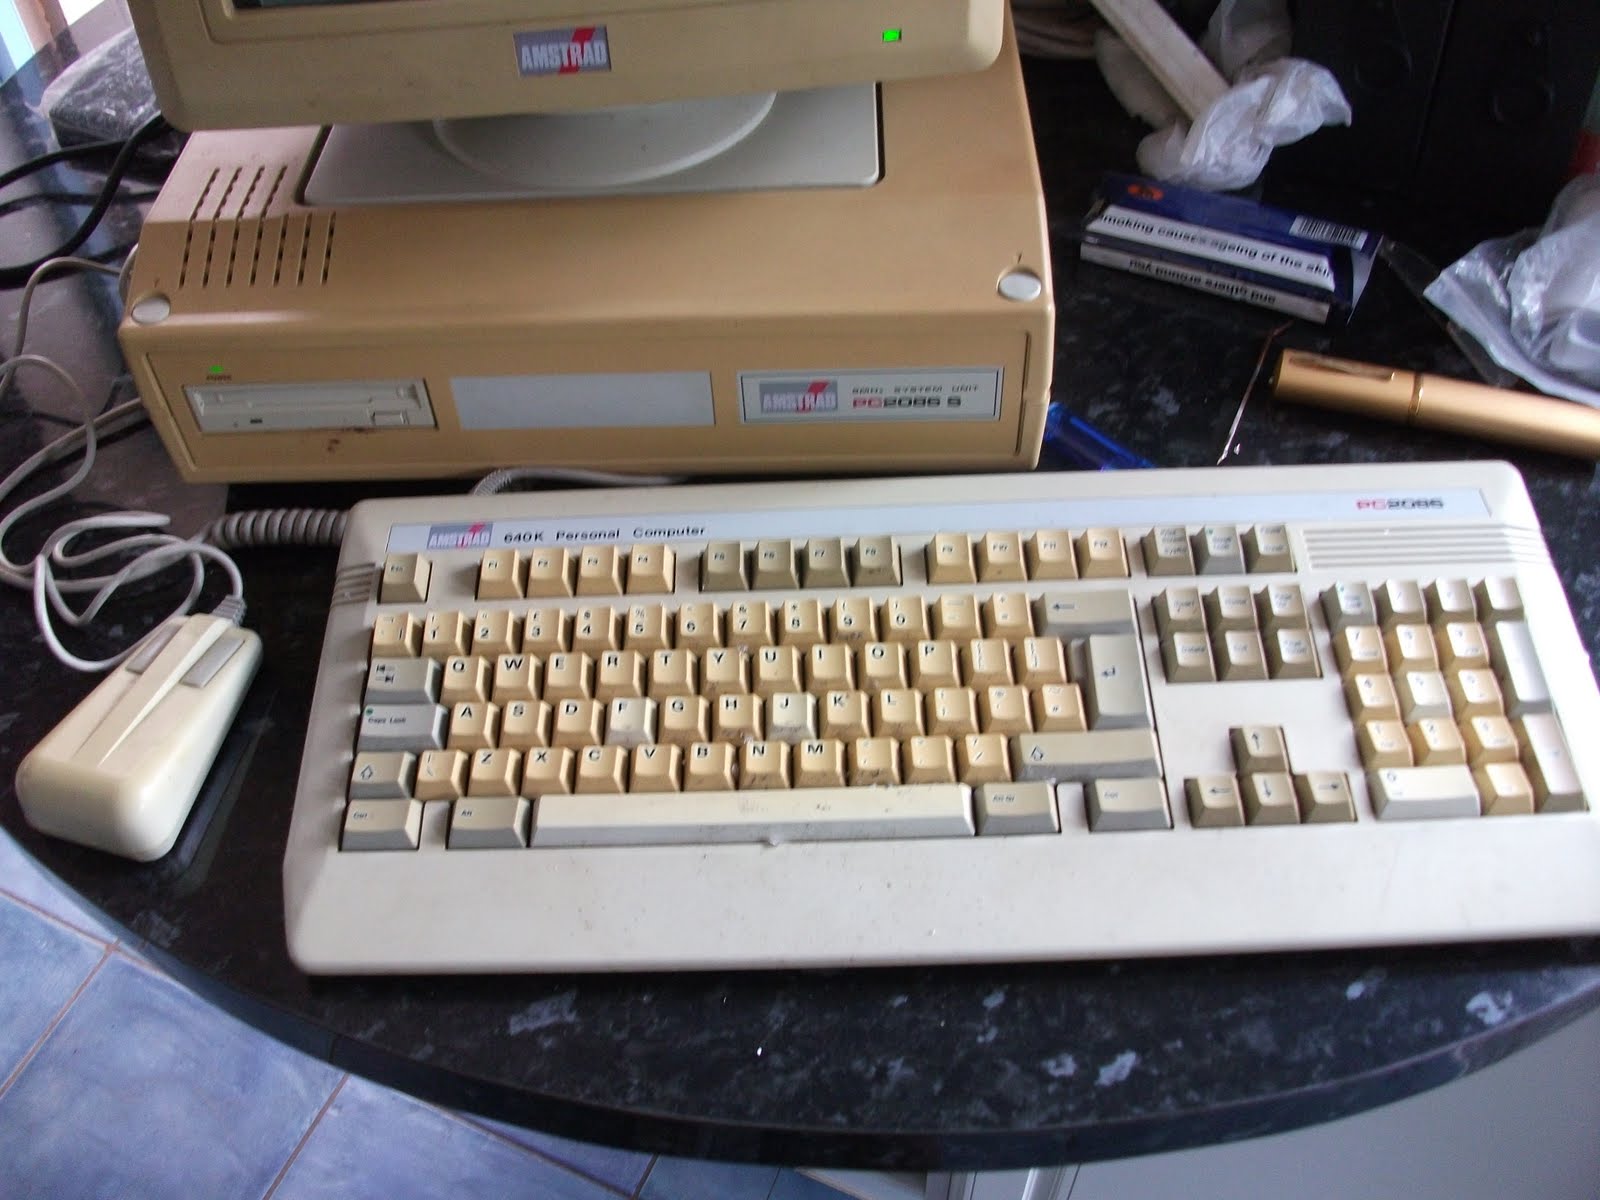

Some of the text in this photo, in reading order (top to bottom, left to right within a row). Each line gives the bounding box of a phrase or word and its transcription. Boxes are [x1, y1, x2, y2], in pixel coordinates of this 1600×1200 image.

[521, 41, 608, 71] AMSTRAD
[1101, 214, 1155, 236] moking
[1210, 239, 1259, 261] ageing
[1262, 250, 1278, 262] of
[1280, 254, 1304, 269] the
[762, 391, 837, 411] AMSTRAD
[1356, 497, 1444, 511] PC2086
[429, 531, 490, 548] AMSTRAD
[503, 526, 706, 545] 640K Personal Computer
[924, 644, 935, 656] P
[607, 656, 619, 668] R
[661, 654, 673, 666] T
[712, 652, 724, 665] Y
[764, 650, 776, 663] U
[452, 660, 466, 673] Q
[504, 658, 523, 671] W
[555, 657, 565, 670] E
[725, 699, 738, 711] H
[780, 697, 790, 709] J
[832, 695, 845, 707] K
[886, 693, 897, 705] L
[460, 706, 473, 719] A
[512, 705, 524, 717] S
[565, 703, 578, 715] D
[617, 702, 628, 714] F
[672, 701, 685, 713] G
[644, 748, 656, 760] V
[696, 746, 709, 758] B
[752, 744, 765, 756] N
[806, 743, 824, 755] M
[480, 752, 492, 765] Z
[535, 751, 548, 763] X
[588, 750, 601, 762] C
